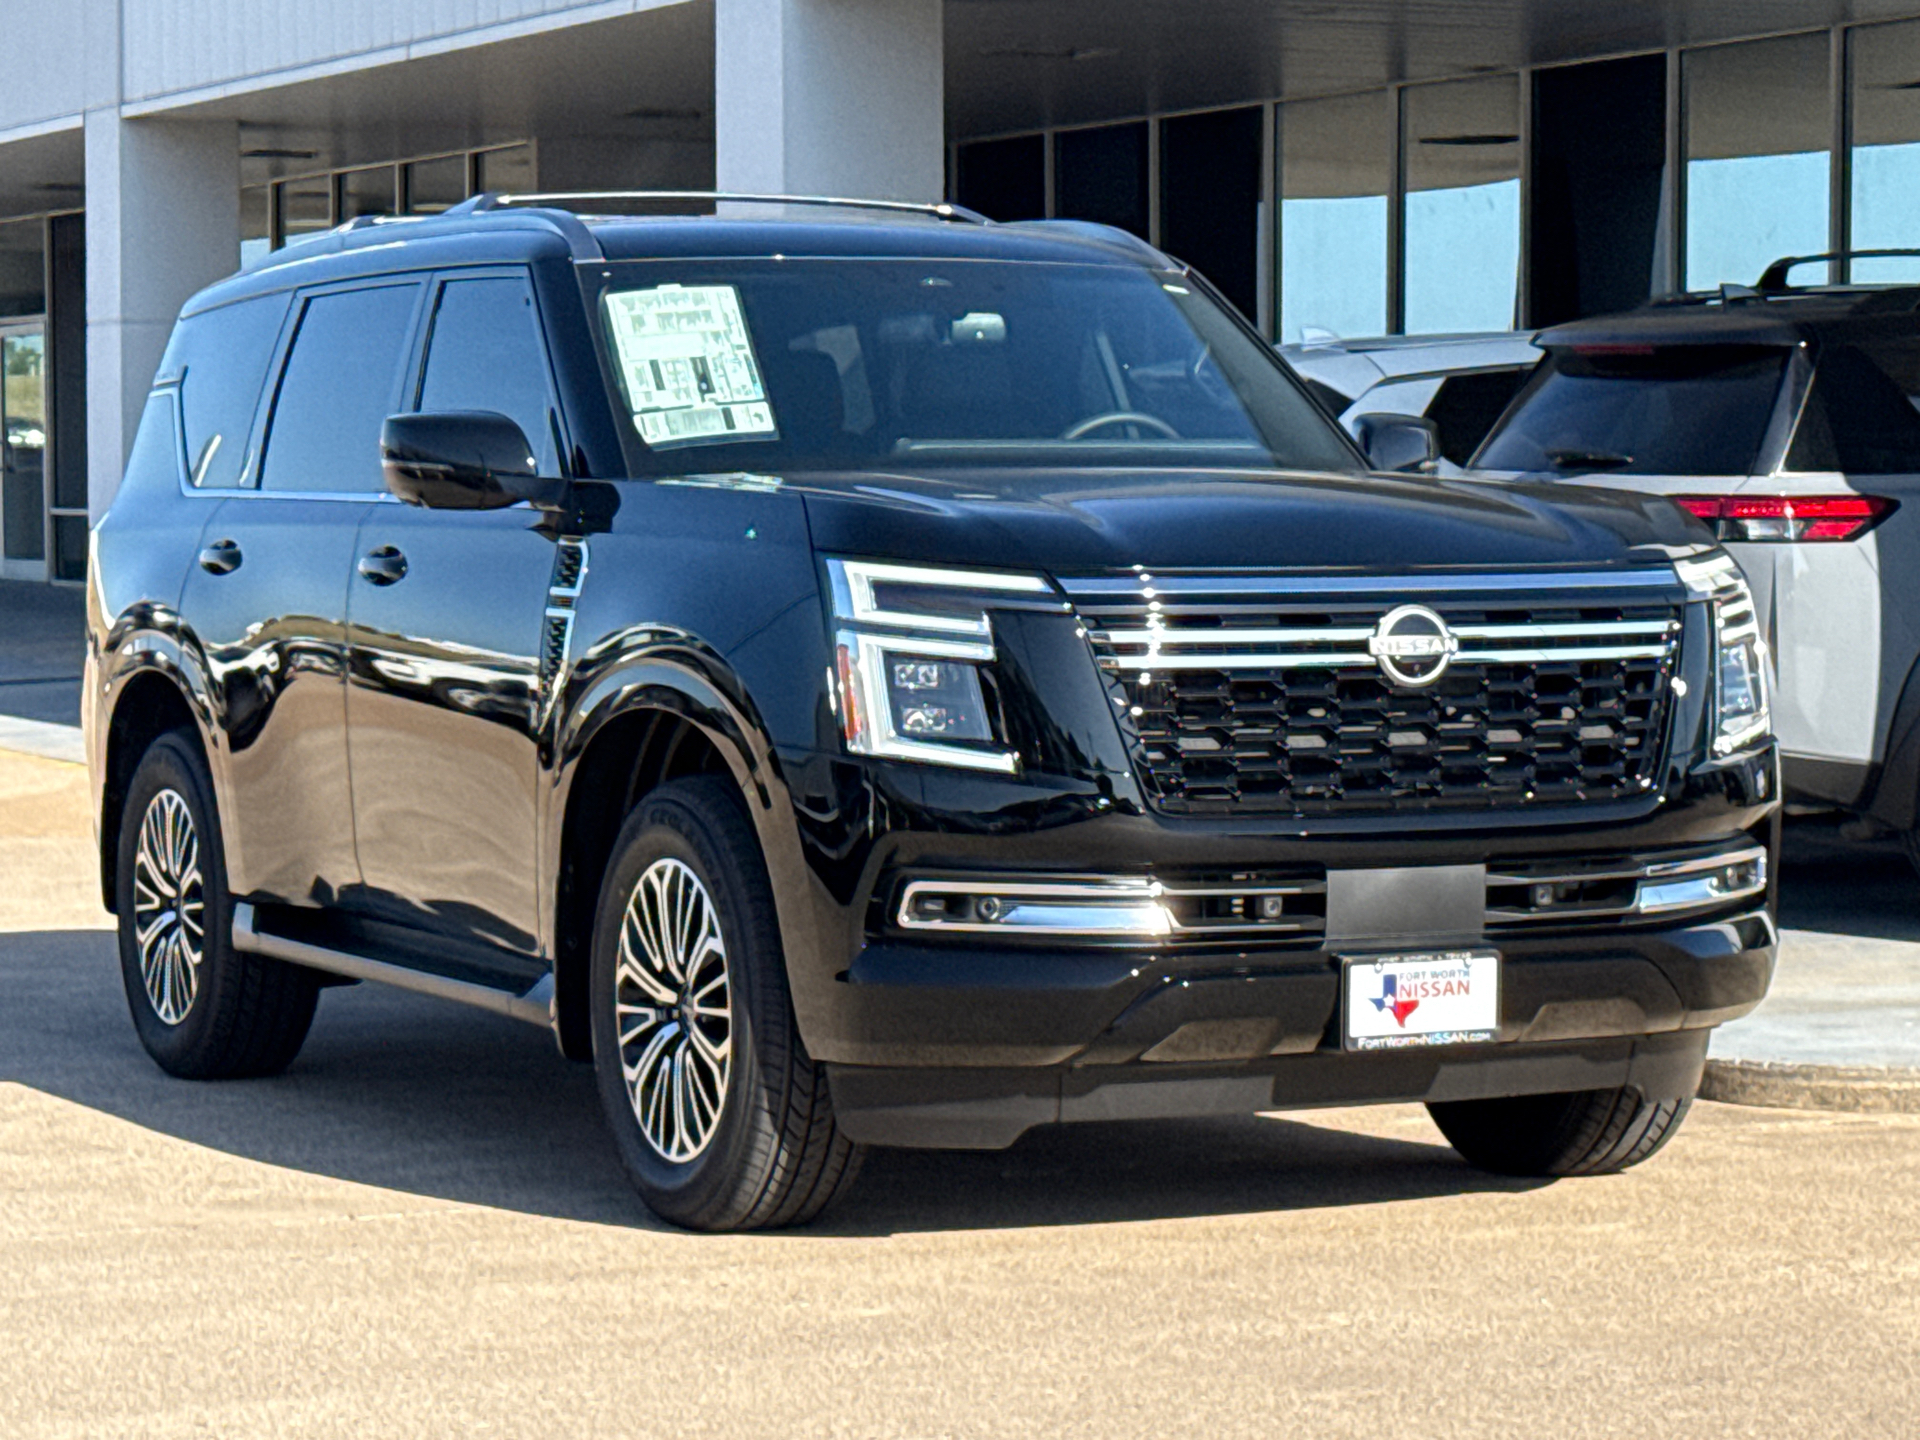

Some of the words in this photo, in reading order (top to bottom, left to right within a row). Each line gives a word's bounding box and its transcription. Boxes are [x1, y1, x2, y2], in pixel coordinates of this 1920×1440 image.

[1371, 637, 1458, 654] NISSAN
[1399, 971, 1427, 982] FORT
[1430, 969, 1470, 980] WORTH
[1399, 980, 1470, 998] NISSAN
